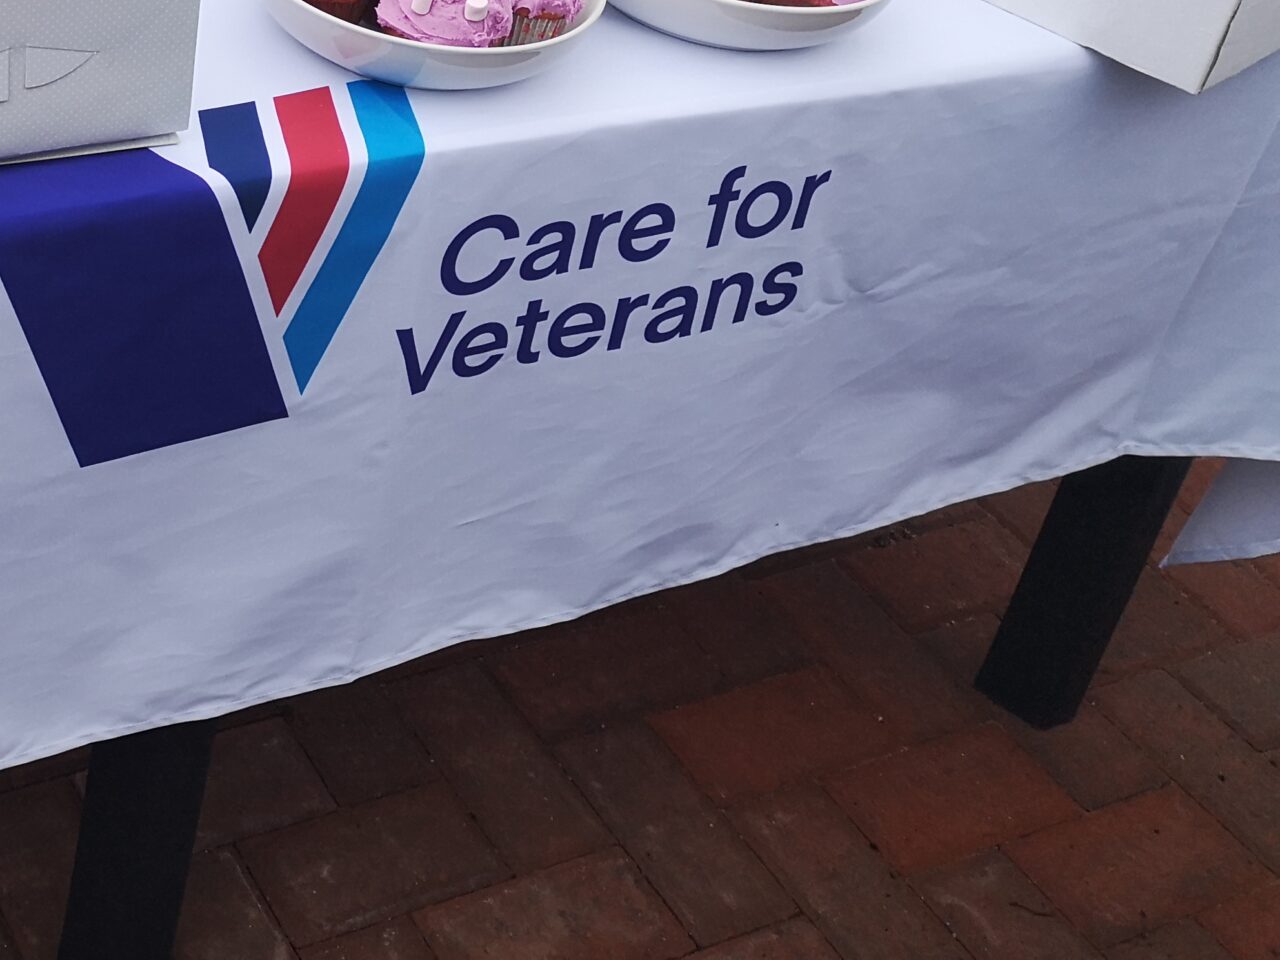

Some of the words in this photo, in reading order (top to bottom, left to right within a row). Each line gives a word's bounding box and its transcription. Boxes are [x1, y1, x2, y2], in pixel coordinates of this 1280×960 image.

[439, 201, 676, 297] Care
[706, 165, 832, 249] for
[395, 260, 803, 396] Veterans
